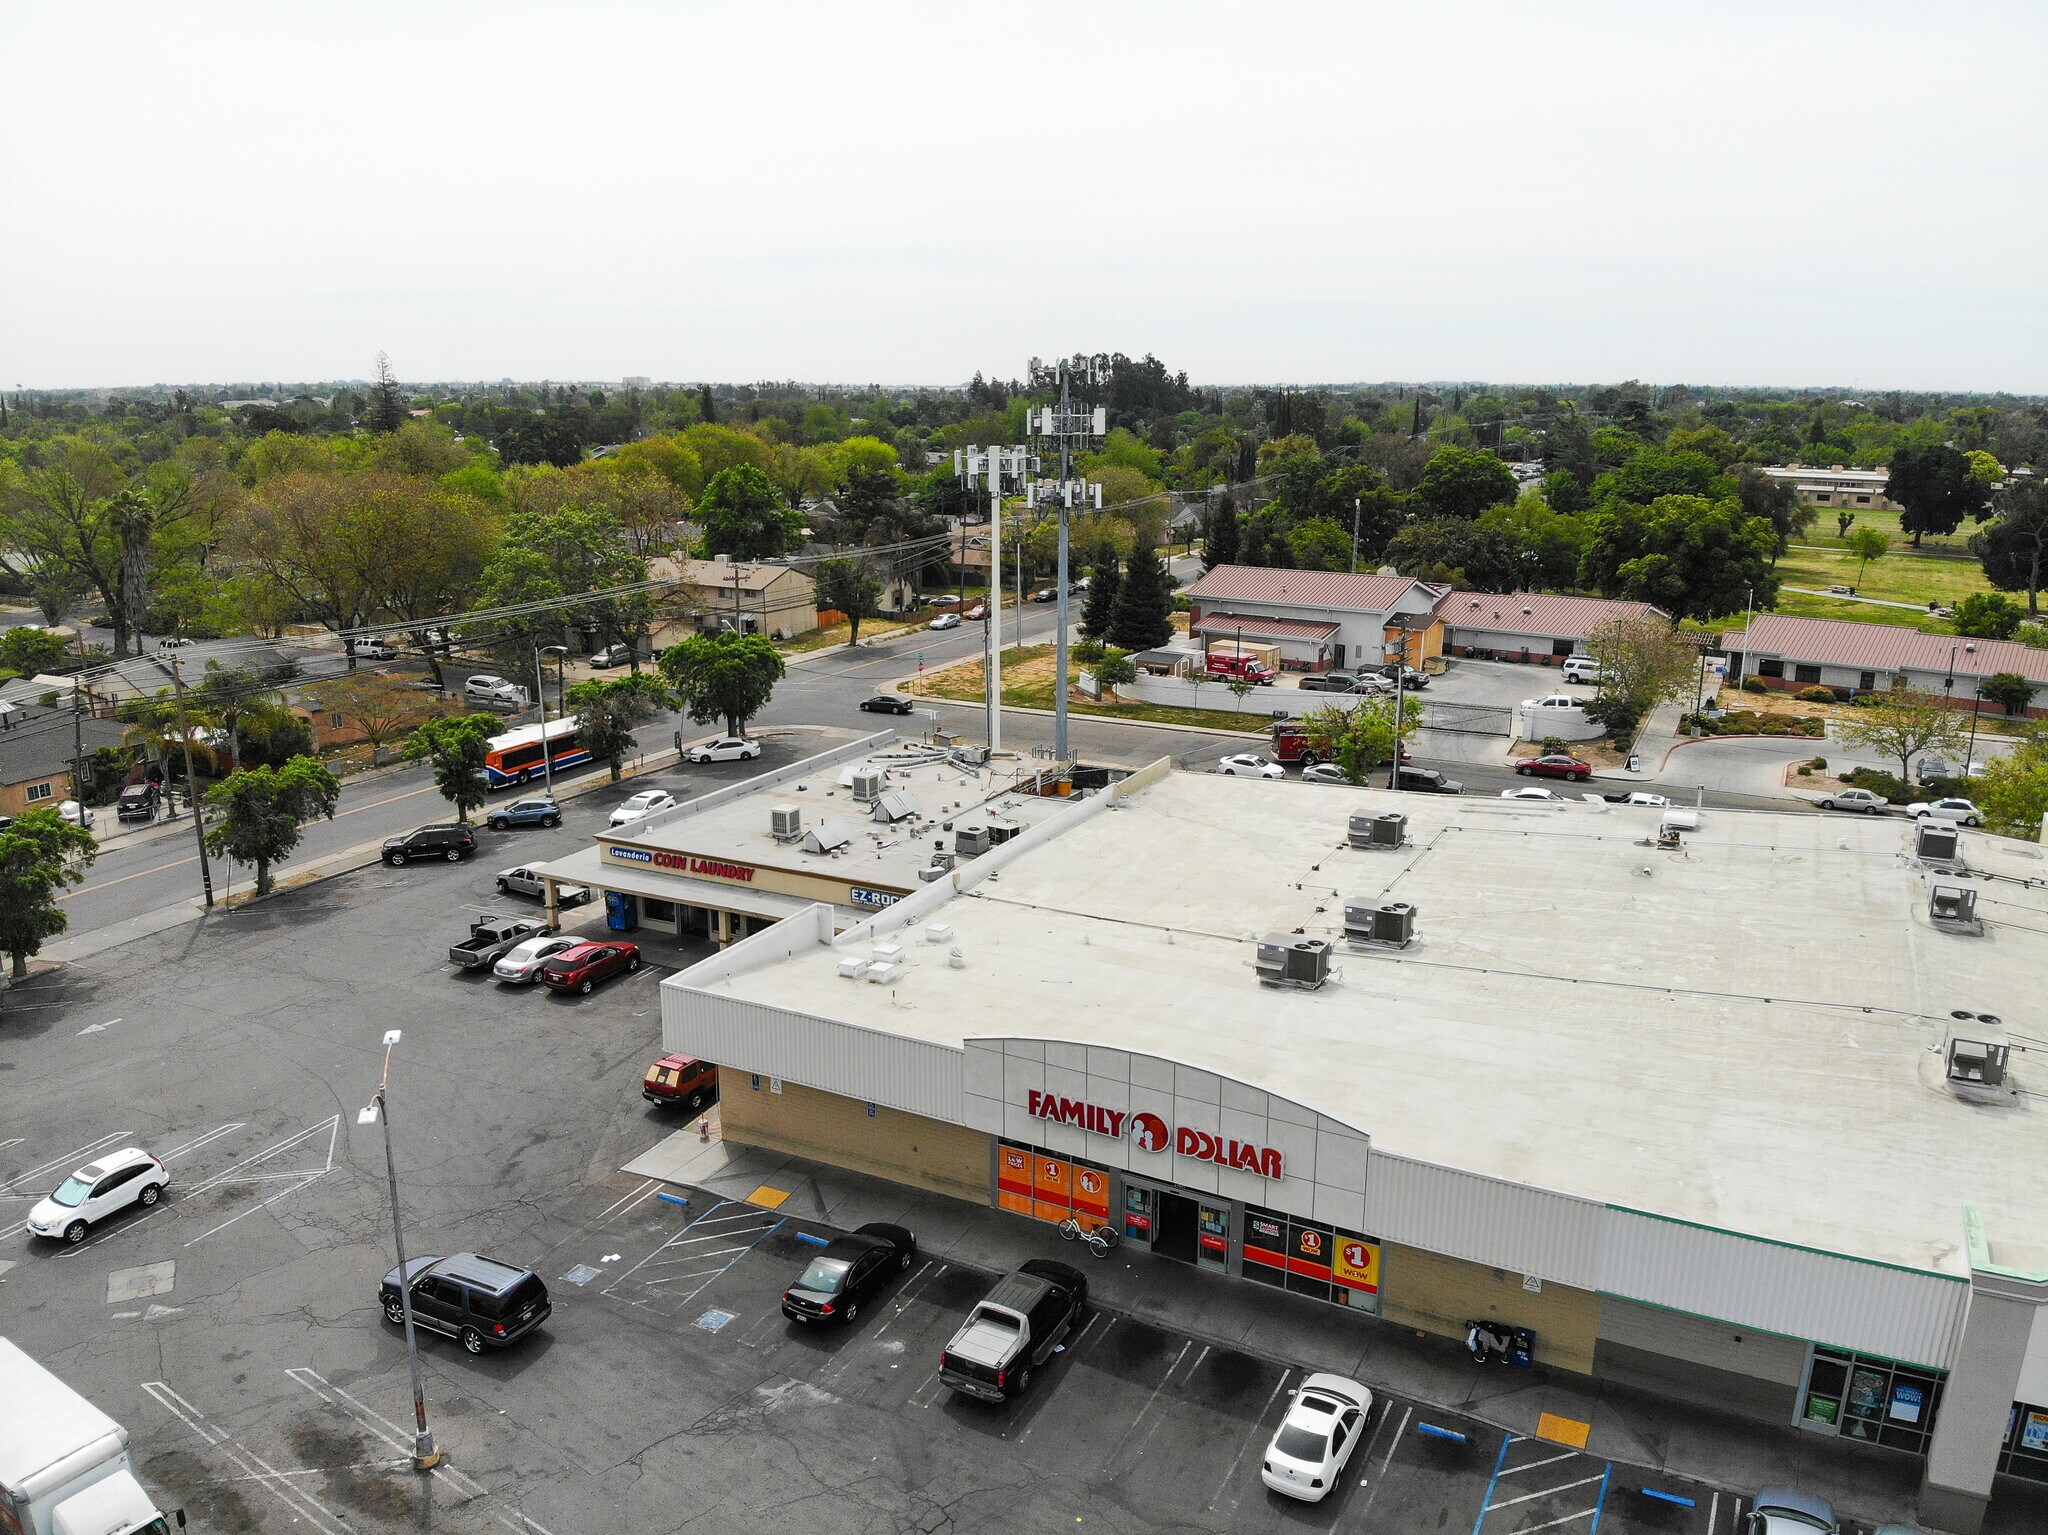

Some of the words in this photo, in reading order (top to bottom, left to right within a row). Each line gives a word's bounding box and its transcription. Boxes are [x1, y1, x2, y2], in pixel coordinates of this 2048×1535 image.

[611, 848, 650, 862] Lavanderia
[653, 853, 688, 870] COIN
[690, 858, 755, 882] LAUNDRY
[1028, 1089, 1126, 1138] FAMILY
[1176, 1126, 1283, 1180] DOLLAR
[1304, 1233, 1316, 1247] $1
[1345, 1246, 1364, 1266] $1
[1896, 1391, 1921, 1403] WOW!
